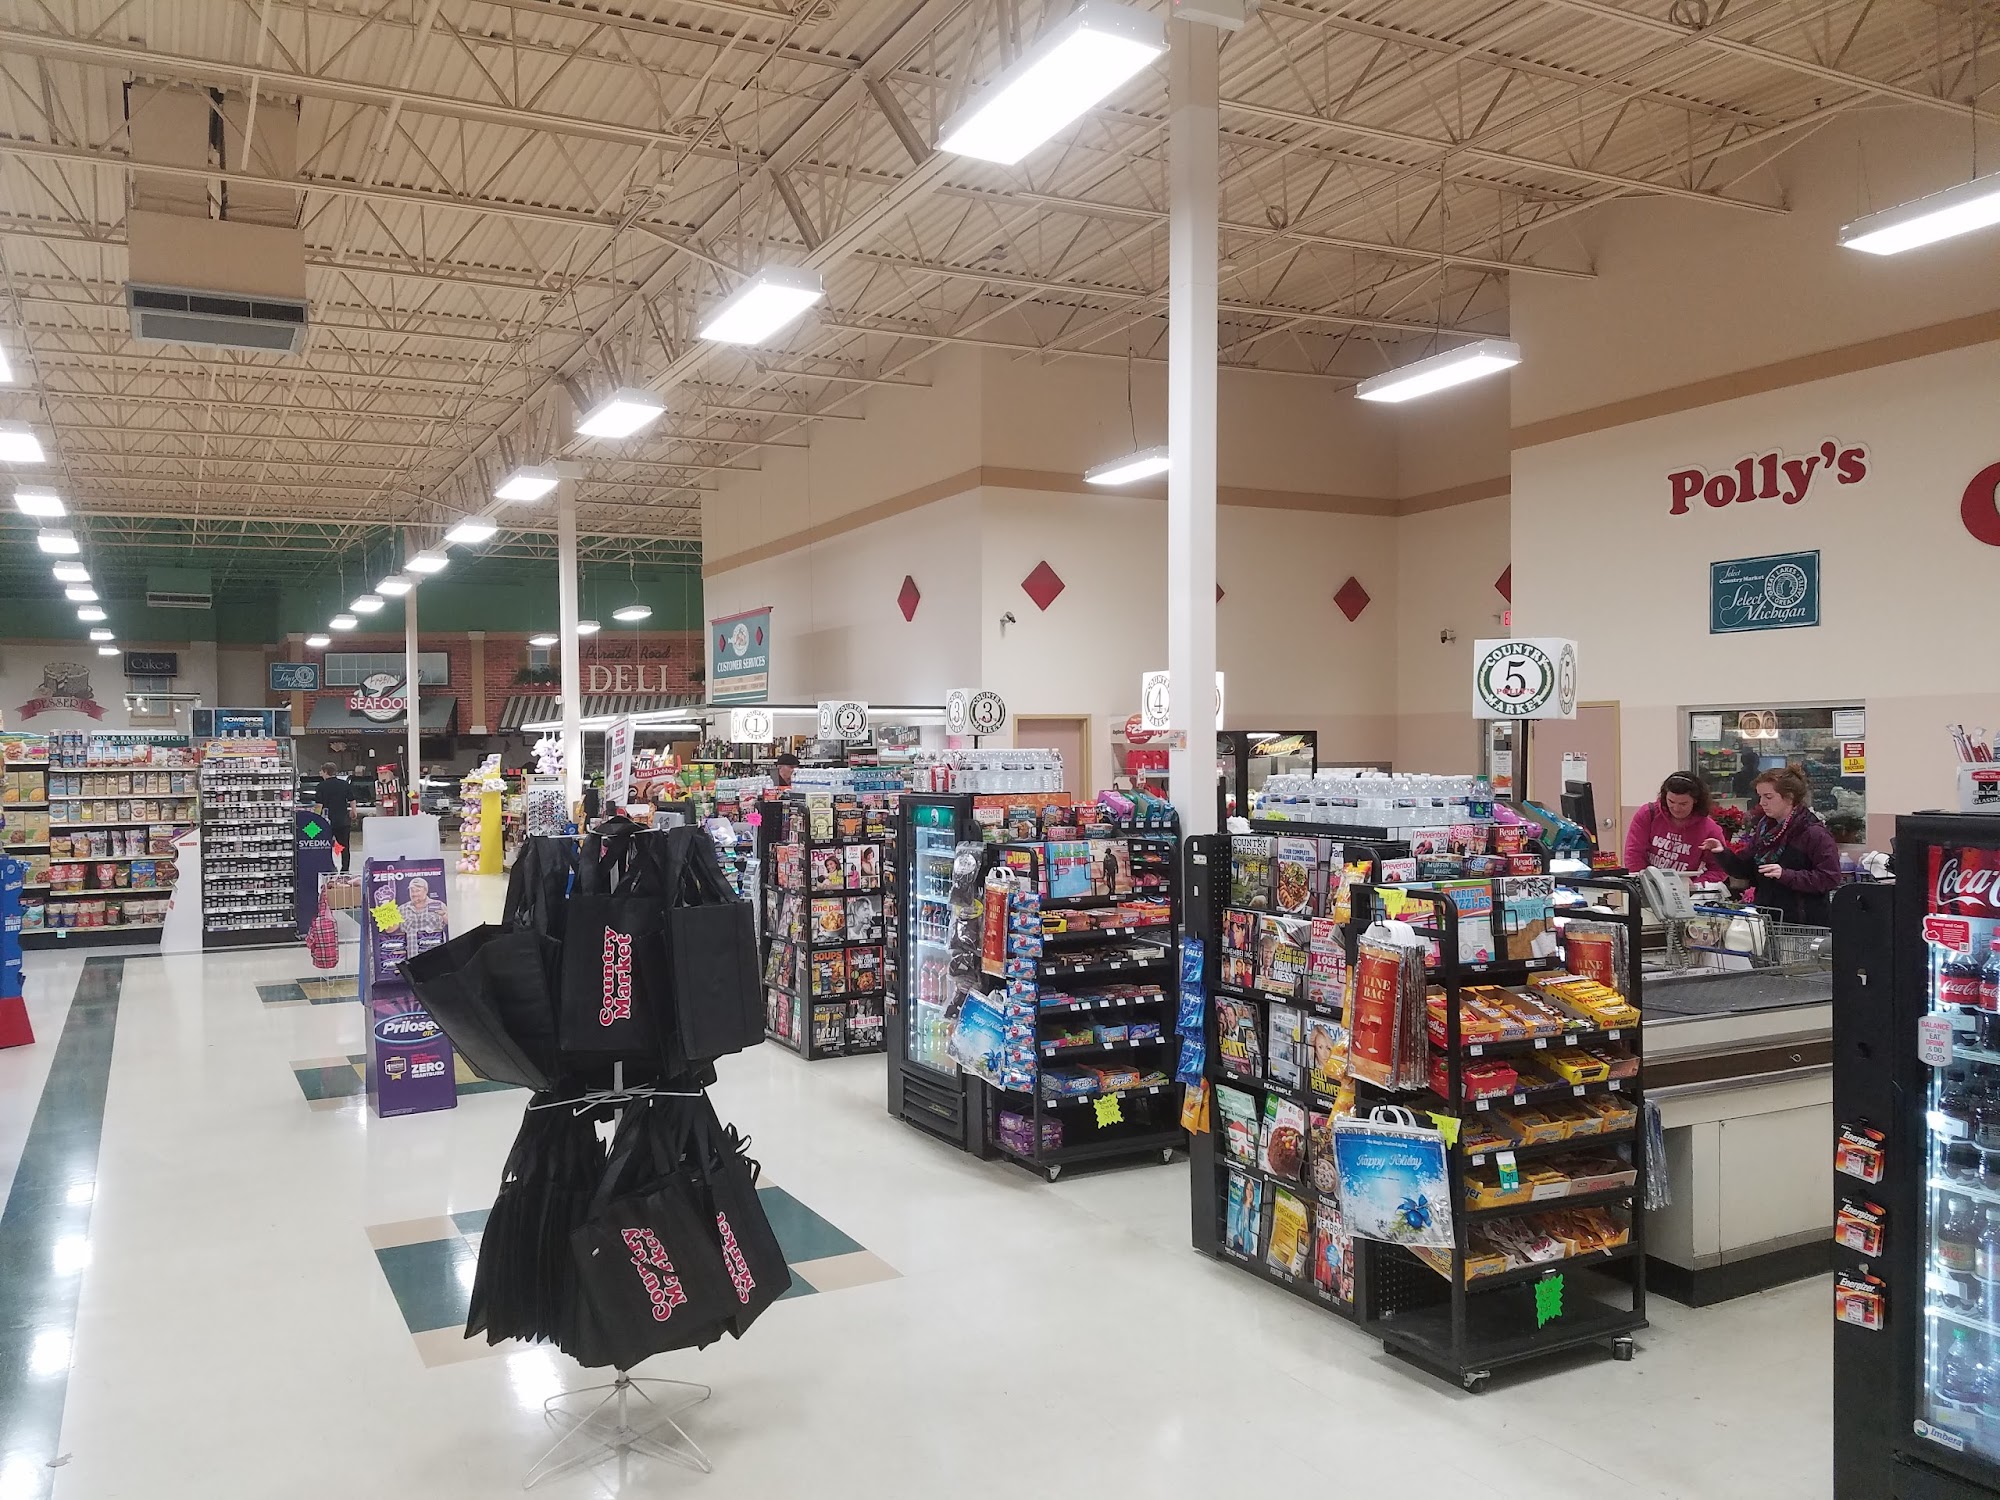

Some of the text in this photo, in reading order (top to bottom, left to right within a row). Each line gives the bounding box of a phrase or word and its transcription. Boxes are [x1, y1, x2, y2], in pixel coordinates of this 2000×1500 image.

[1667, 441, 1867, 515] Polly's
[1776, 567, 1797, 575] LAKES
[1719, 583, 1764, 610] Select
[1720, 599, 1806, 626] Michigan
[641, 646, 671, 659] Road
[1485, 644, 1549, 666] COUNTRY
[131, 658, 171, 670] Cakes
[717, 656, 766, 672] CUSTOMER SERVICES
[588, 665, 668, 692] DELI
[1506, 660, 1526, 698] 5
[32, 697, 94, 710] DESSERTS
[973, 692, 1004, 704] COUNTRY
[1154, 687, 1163, 714] 4
[1485, 694, 1544, 714] MARKET
[983, 702, 993, 722] 3
[753, 718, 760, 732] 1
[846, 712, 856, 729] 2
[1256, 741, 1306, 754] Pinnacle
[654, 768, 674, 776] Debbie
[1416, 831, 1448, 839] Prevention
[1499, 828, 1527, 836] Reader's
[1233, 838, 1268, 847] COUNTRY
[1440, 838, 1447, 847] 50
[1652, 836, 1692, 855] WORK
[1233, 847, 1267, 857] GARDENS
[1658, 849, 1679, 860] FOR
[1007, 854, 1043, 865] PUZZS
[1382, 862, 1415, 870] Prevention
[1513, 858, 1541, 866] Reader's
[373, 872, 404, 881] ZERO
[1936, 858, 2000, 907] Coca-C
[1450, 889, 1485, 898] VARIETY
[1458, 897, 1491, 909] ZZLES
[1313, 928, 1330, 938] Wor
[813, 952, 842, 961] SOUPS
[1317, 957, 1336, 966] LOSE
[600, 925, 618, 1026] Country
[614, 934, 632, 1019] Market
[1273, 972, 1296, 983] MESS!
[1363, 975, 1391, 991] WINE
[1364, 987, 1385, 1000] BAG
[1921, 1021, 1950, 1030] BALANCE
[411, 1061, 445, 1073] ZERO
[1276, 1086, 1292, 1096] SIMPLE
[1478, 1089, 1507, 1099] Skittles
[1843, 1131, 1878, 1148] Energizer
[1357, 1154, 1424, 1169] Happy Holiday
[1843, 1204, 1878, 1223] Energizer
[716, 1211, 756, 1291] Market
[1939, 1247, 1965, 1260] oke
[621, 1228, 687, 1322] Country Market
[722, 1245, 750, 1304] Coun
[1840, 1278, 1875, 1292] Energizer
[1931, 1428, 1962, 1447] Imbera
